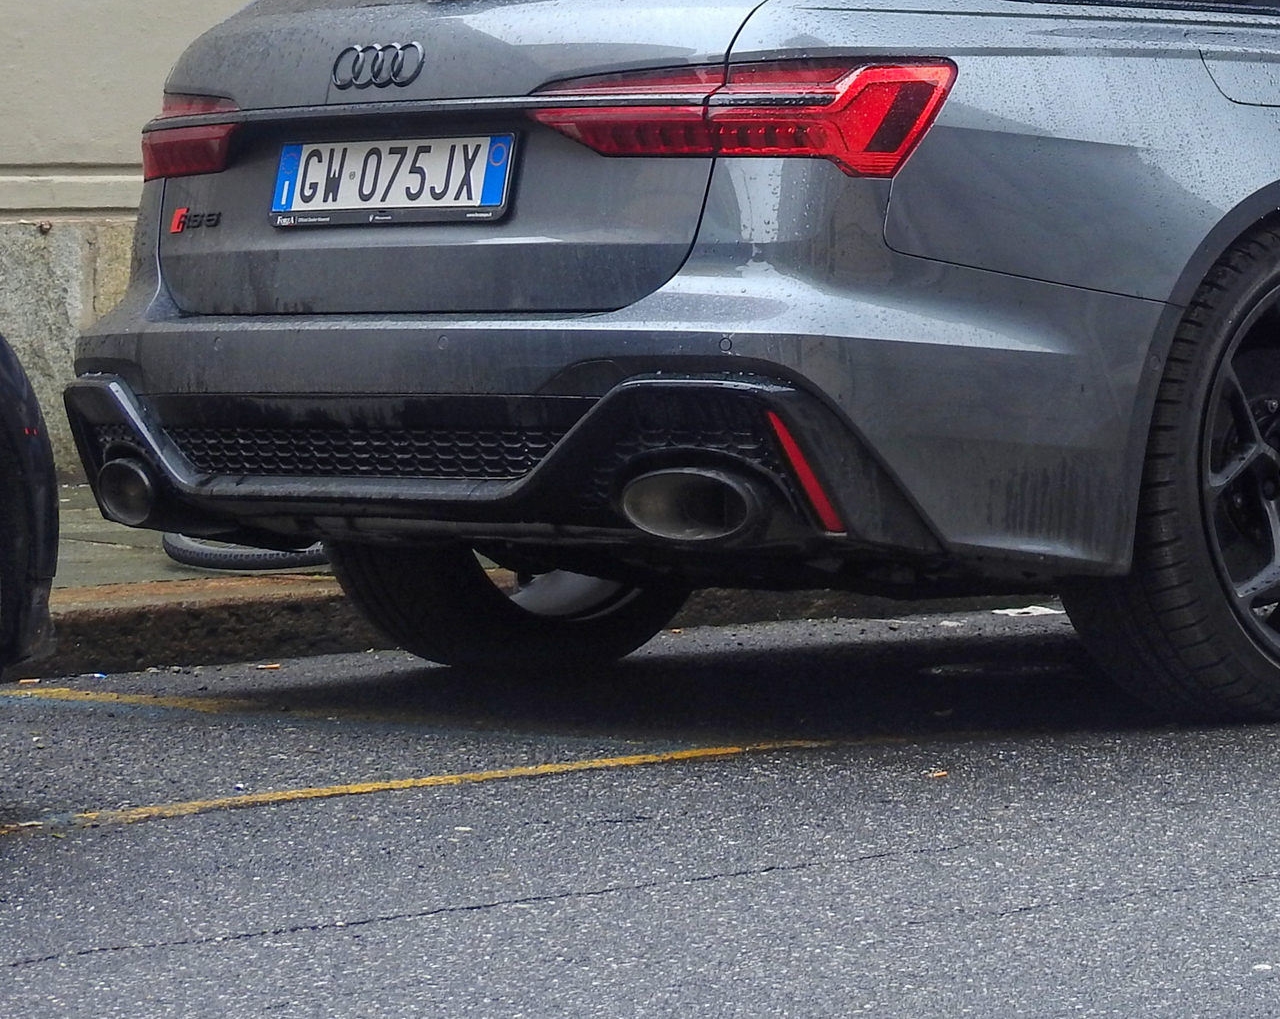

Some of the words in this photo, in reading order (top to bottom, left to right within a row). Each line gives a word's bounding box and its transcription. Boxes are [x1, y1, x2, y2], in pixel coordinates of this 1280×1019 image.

[299, 147, 350, 204] GW
[358, 143, 482, 203] 075JX
[170, 207, 222, 234] RS6
